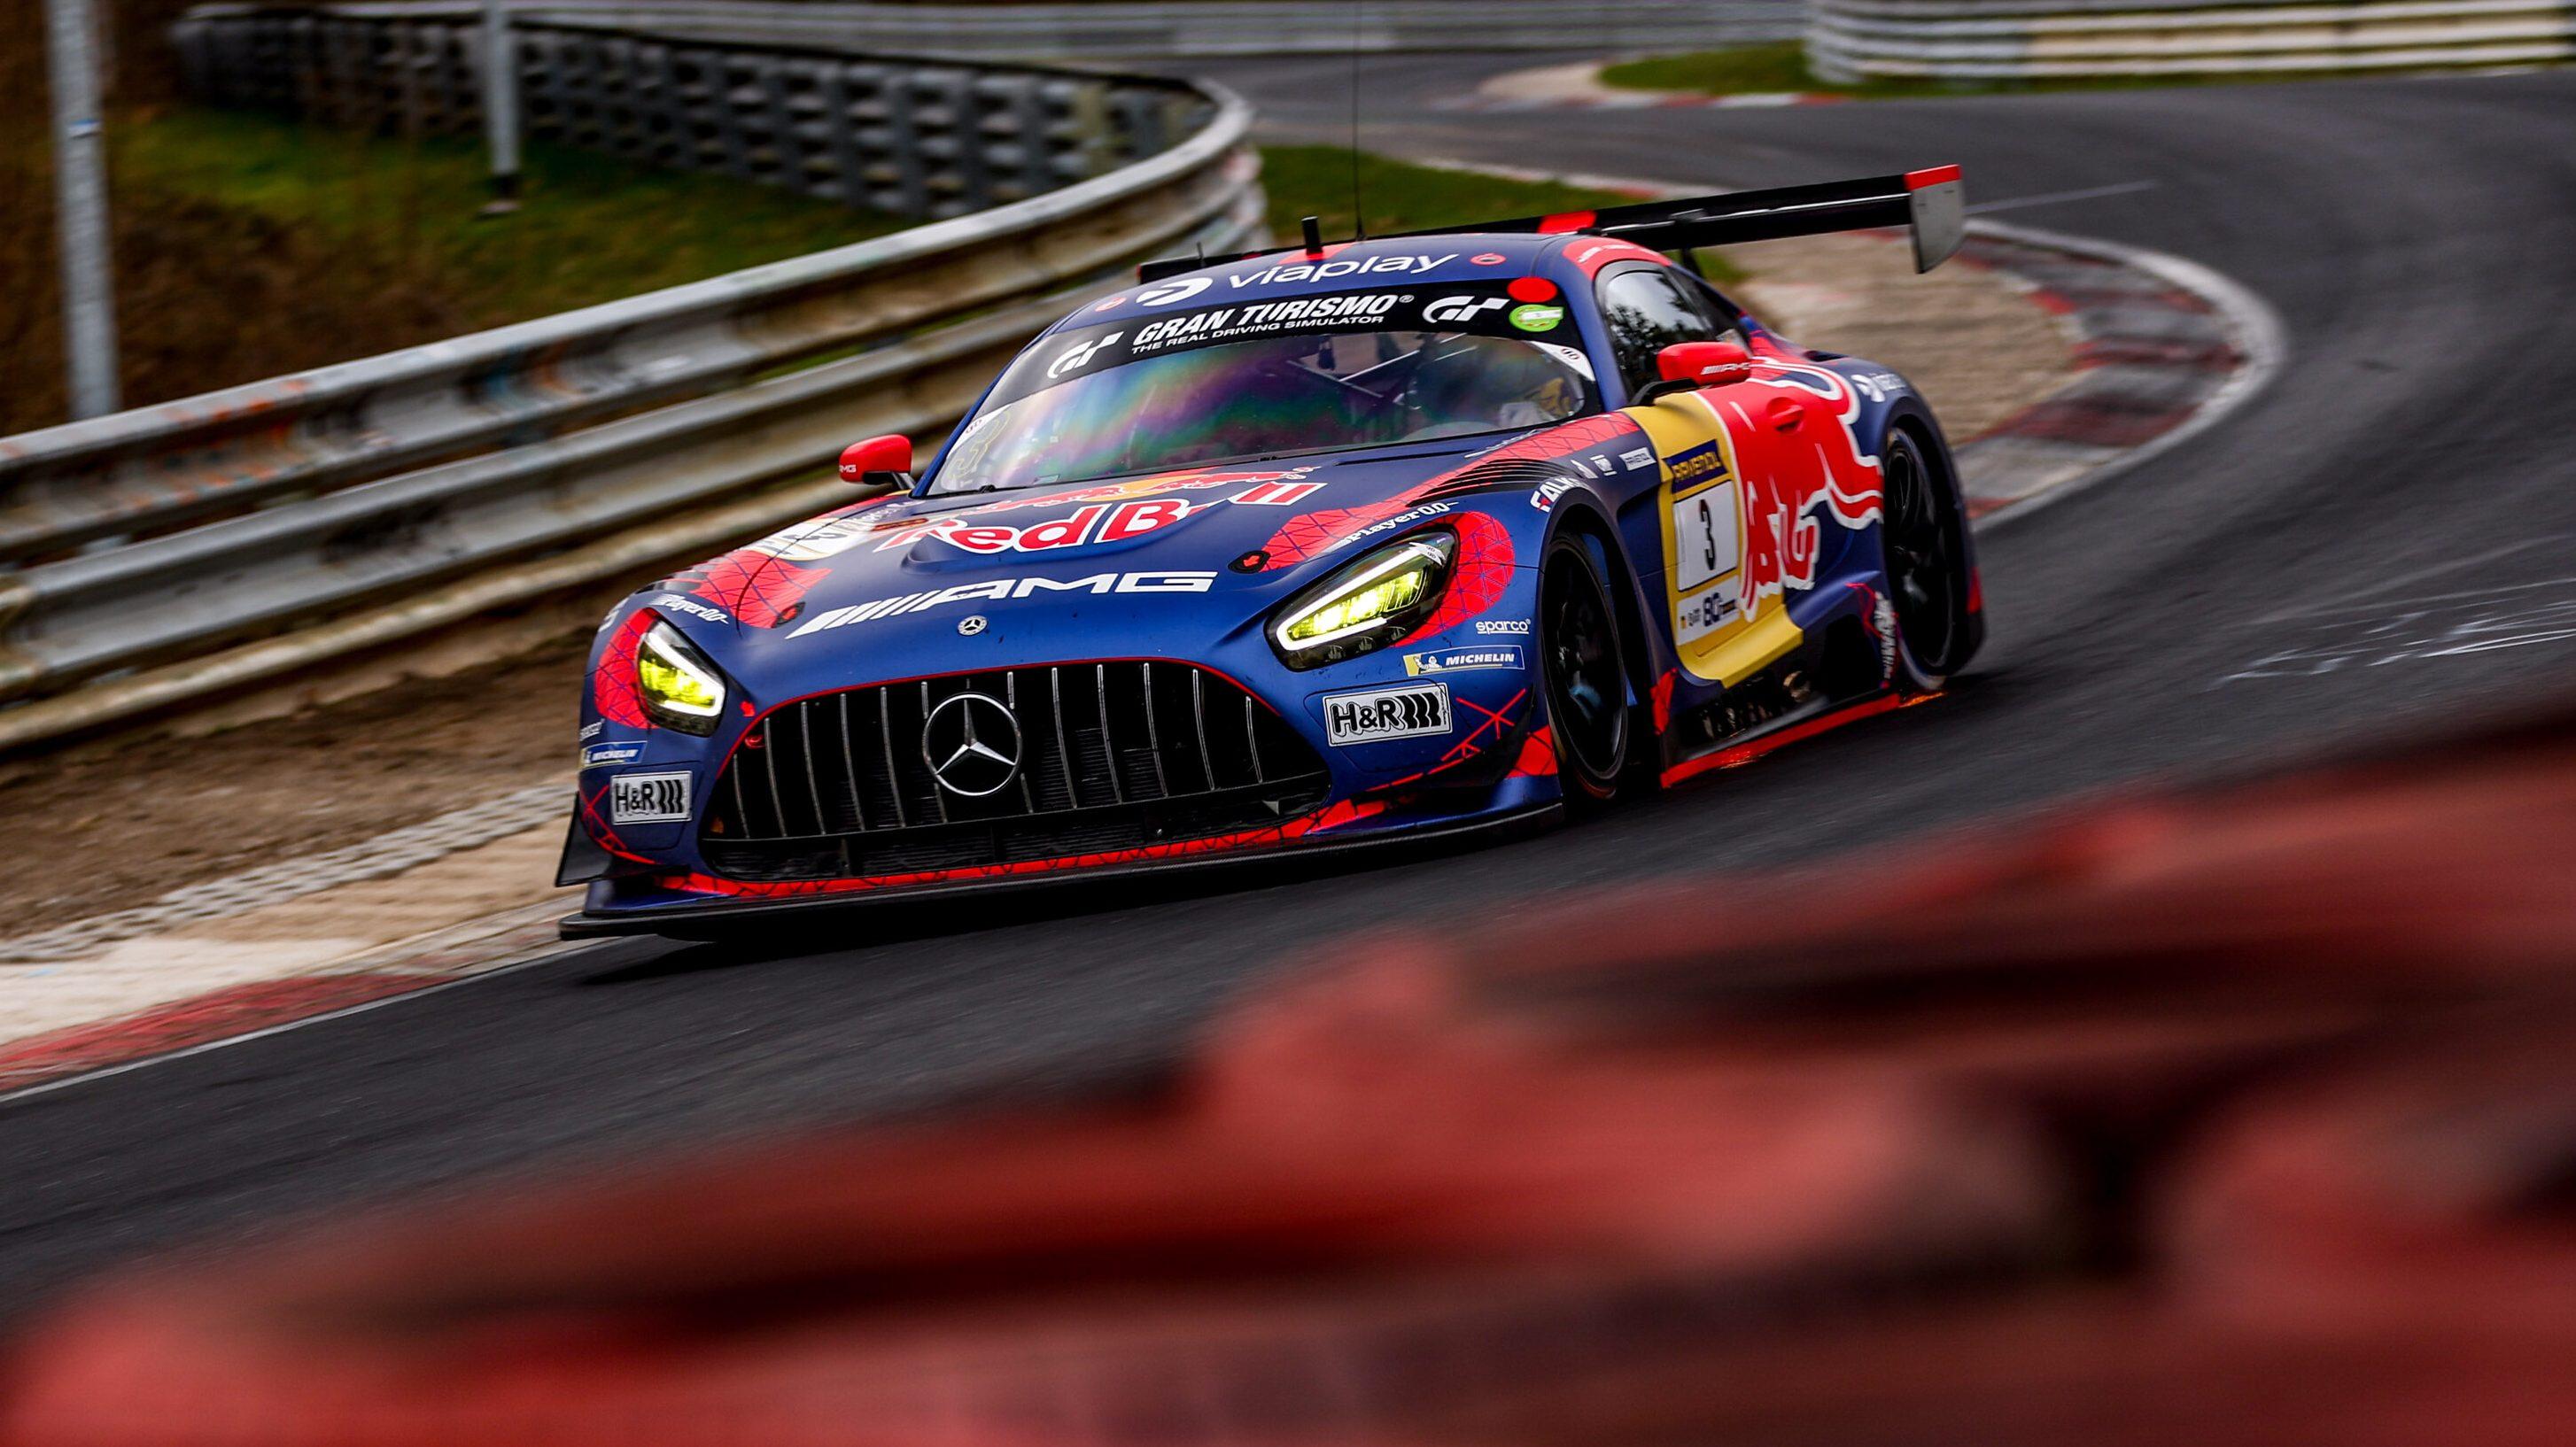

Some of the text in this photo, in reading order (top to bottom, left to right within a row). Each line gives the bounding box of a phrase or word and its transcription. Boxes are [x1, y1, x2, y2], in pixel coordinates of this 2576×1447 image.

[1229, 253, 1460, 290] viaplay
[1132, 315, 1385, 354] THE REAL DRIVING SIMULATOR
[1133, 294, 1400, 345] GRAN TURISMO
[1530, 476, 1592, 513] FALK
[1093, 483, 1328, 544] Bll
[1351, 508, 1420, 542] Player
[1699, 499, 1716, 570] 3
[1475, 621, 1528, 635] sparco
[1446, 654, 1515, 666] MICHELIN
[1331, 699, 1401, 735] H&R
[615, 779, 655, 815] H&R
